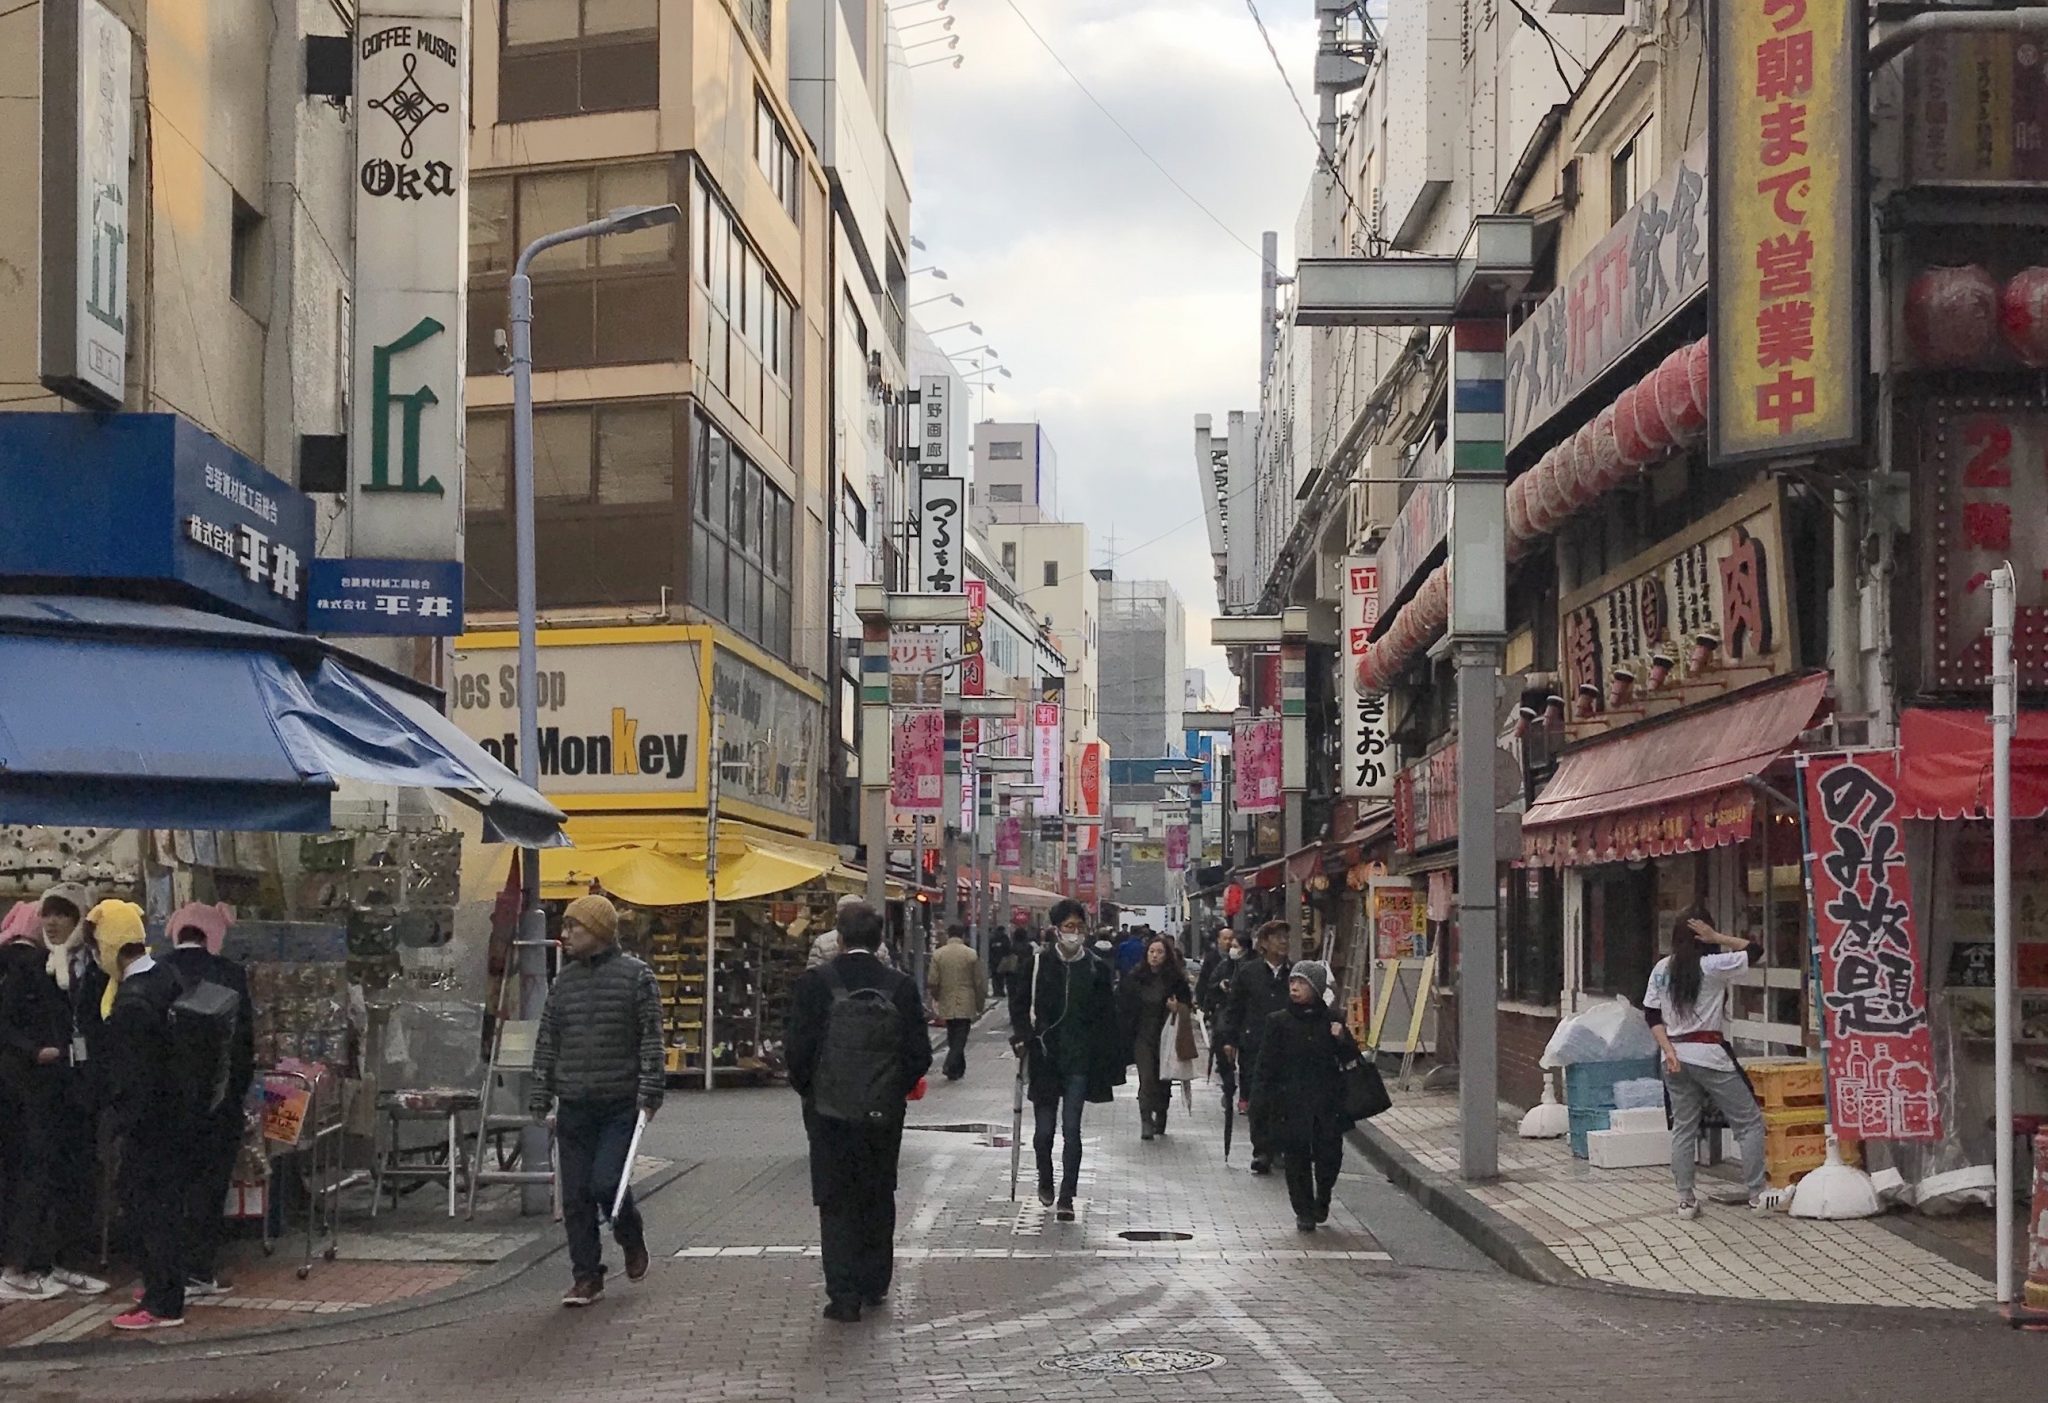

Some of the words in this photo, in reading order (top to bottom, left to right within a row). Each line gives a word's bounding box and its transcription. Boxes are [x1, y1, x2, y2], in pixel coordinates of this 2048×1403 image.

[362, 26, 412, 61] COFFEE
[417, 29, 457, 68] MUSIC
[361, 158, 457, 201] Oka
[926, 382, 942, 459] 上野画廊
[190, 514, 235, 559] 株式会社
[239, 523, 299, 601] 平井
[317, 599, 367, 611] 株式会社
[374, 595, 453, 617] 平井
[499, 664, 566, 712] Sop
[538, 707, 688, 779] Monkey
[1816, 763, 1927, 1036] のみ放題
